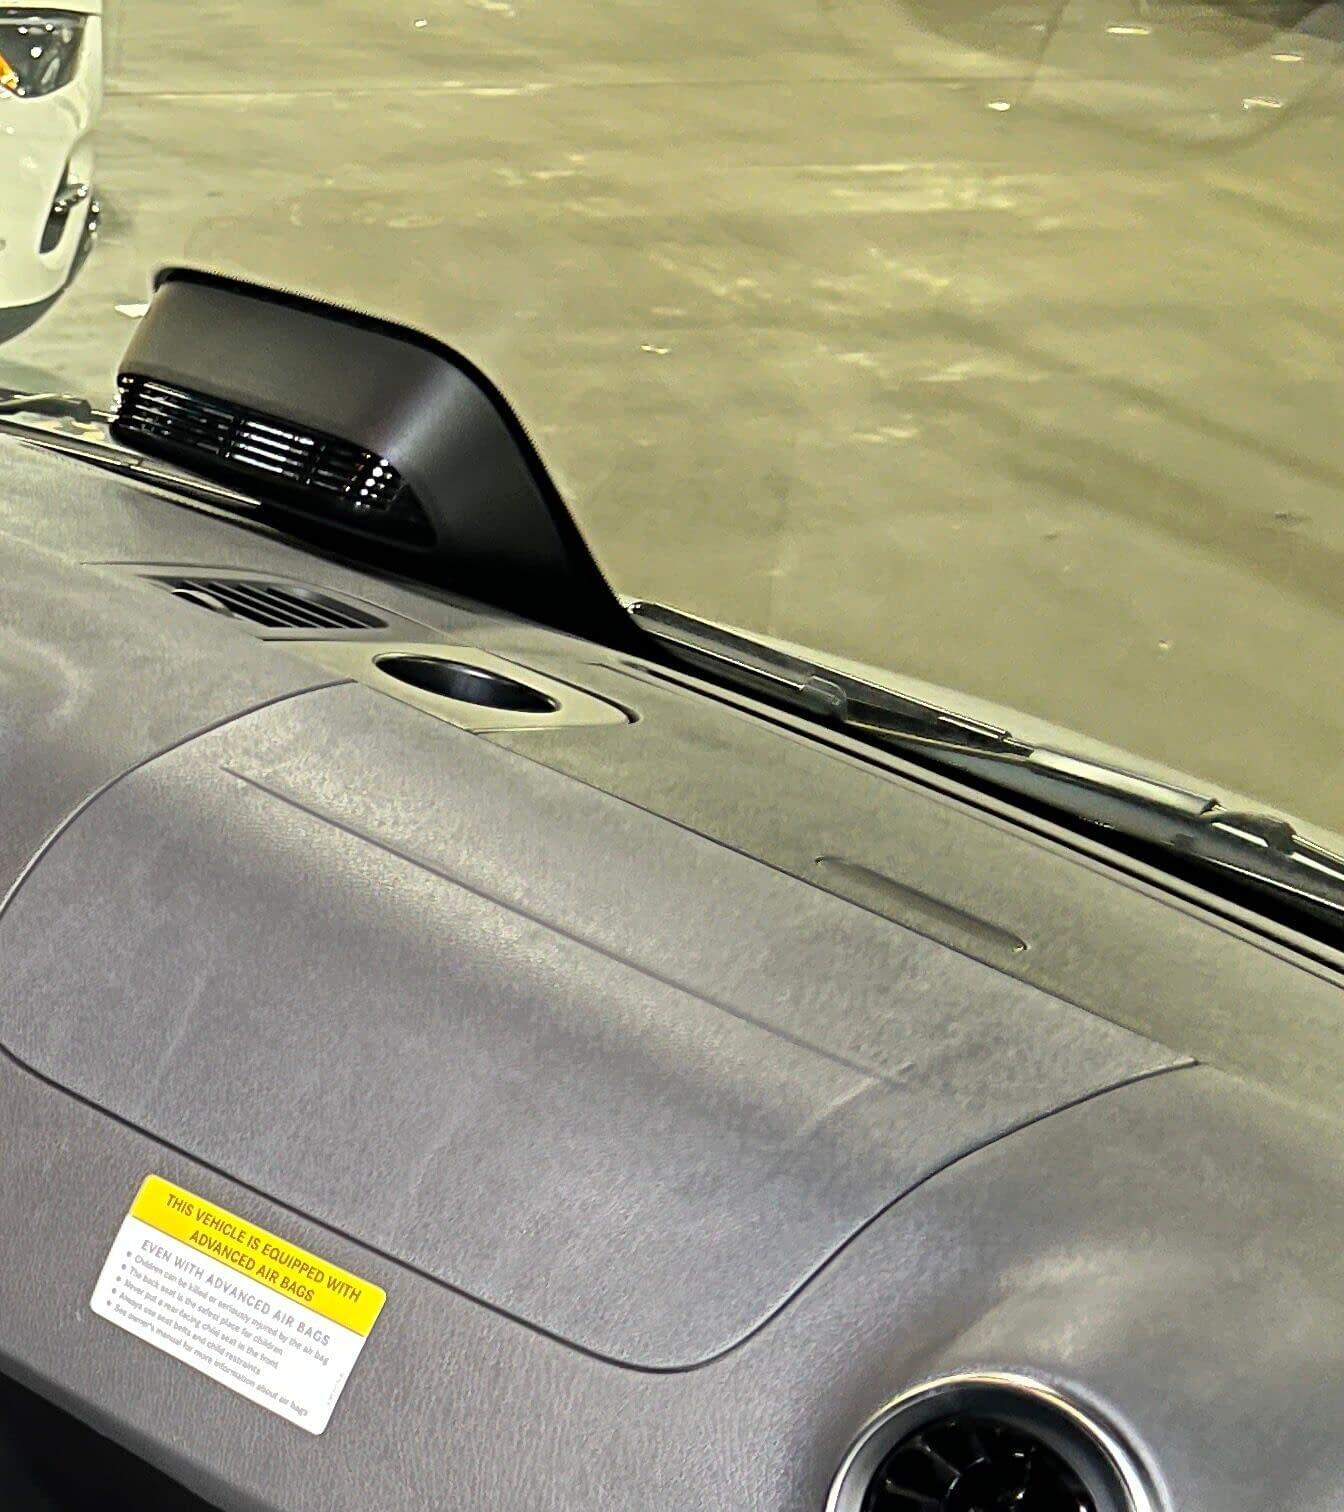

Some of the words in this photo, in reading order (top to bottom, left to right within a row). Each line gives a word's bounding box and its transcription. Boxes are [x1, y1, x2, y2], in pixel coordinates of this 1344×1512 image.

[140, 1239, 173, 1262] EVEN
[173, 1255, 205, 1280] WITH
[205, 1273, 271, 1314] ADVANCED
[271, 1309, 295, 1328] AIR
[296, 1321, 330, 1346] BAGS
[166, 1193, 194, 1217] THIS
[195, 1208, 247, 1244] VEHICLE
[246, 1235, 261, 1251] IS
[260, 1243, 325, 1283] EQUIPPED
[326, 1275, 362, 1303] WITH
[188, 1229, 256, 1271] ADVANCED
[255, 1264, 280, 1284] AIR
[279, 1275, 315, 1302] BAGS
